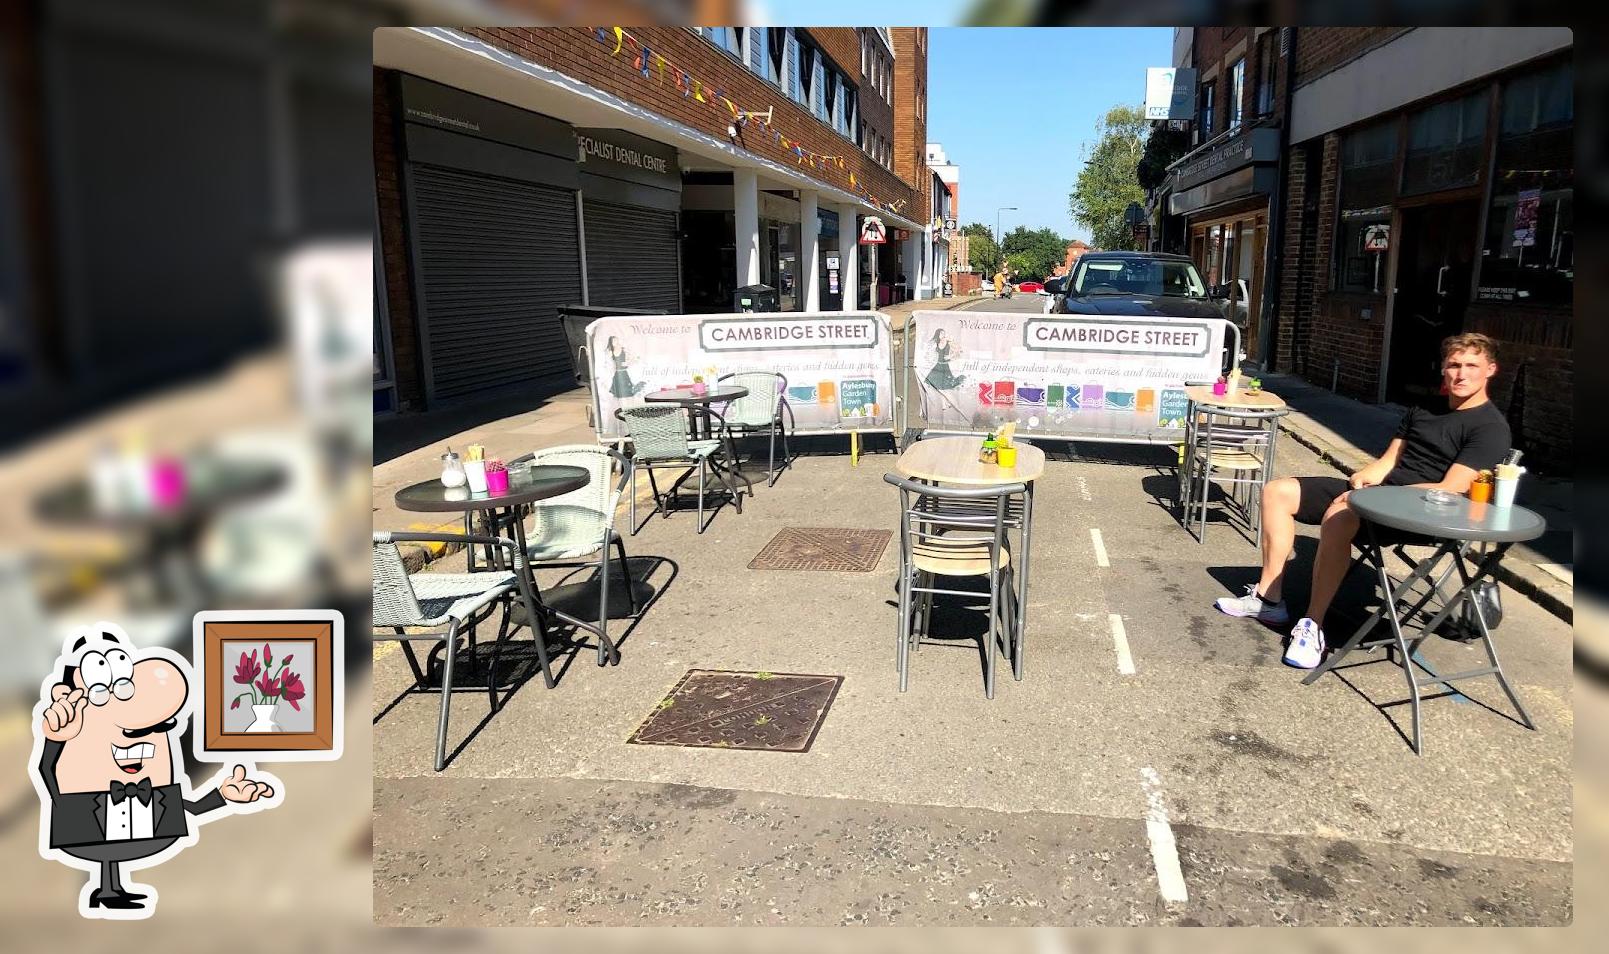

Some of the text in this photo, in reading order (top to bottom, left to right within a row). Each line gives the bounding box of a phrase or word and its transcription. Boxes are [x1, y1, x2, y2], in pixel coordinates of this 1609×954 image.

[1150, 107, 1170, 116] NHS
[615, 146, 642, 167] DENTAL
[643, 154, 667, 173] CENTRE
[630, 324, 692, 335] Welcome to
[959, 319, 1017, 331] Welcome to
[711, 324, 868, 342] CAMBRIDGE STREET
[1035, 326, 1199, 346] CAMBRIDGE STREET
[641, 366, 658, 377] full
[803, 362, 820, 371] and
[823, 360, 854, 370] hidden
[962, 361, 979, 372] full
[981, 361, 991, 373] of
[992, 362, 1048, 374] independent
[1085, 367, 1121, 376] eateries
[1123, 368, 1143, 377] and
[1145, 367, 1179, 379] hidden
[842, 382, 875, 390] Aylesbury
[843, 397, 862, 405] Town
[1163, 391, 1188, 400] Ayles
[1162, 407, 1182, 415] Town
